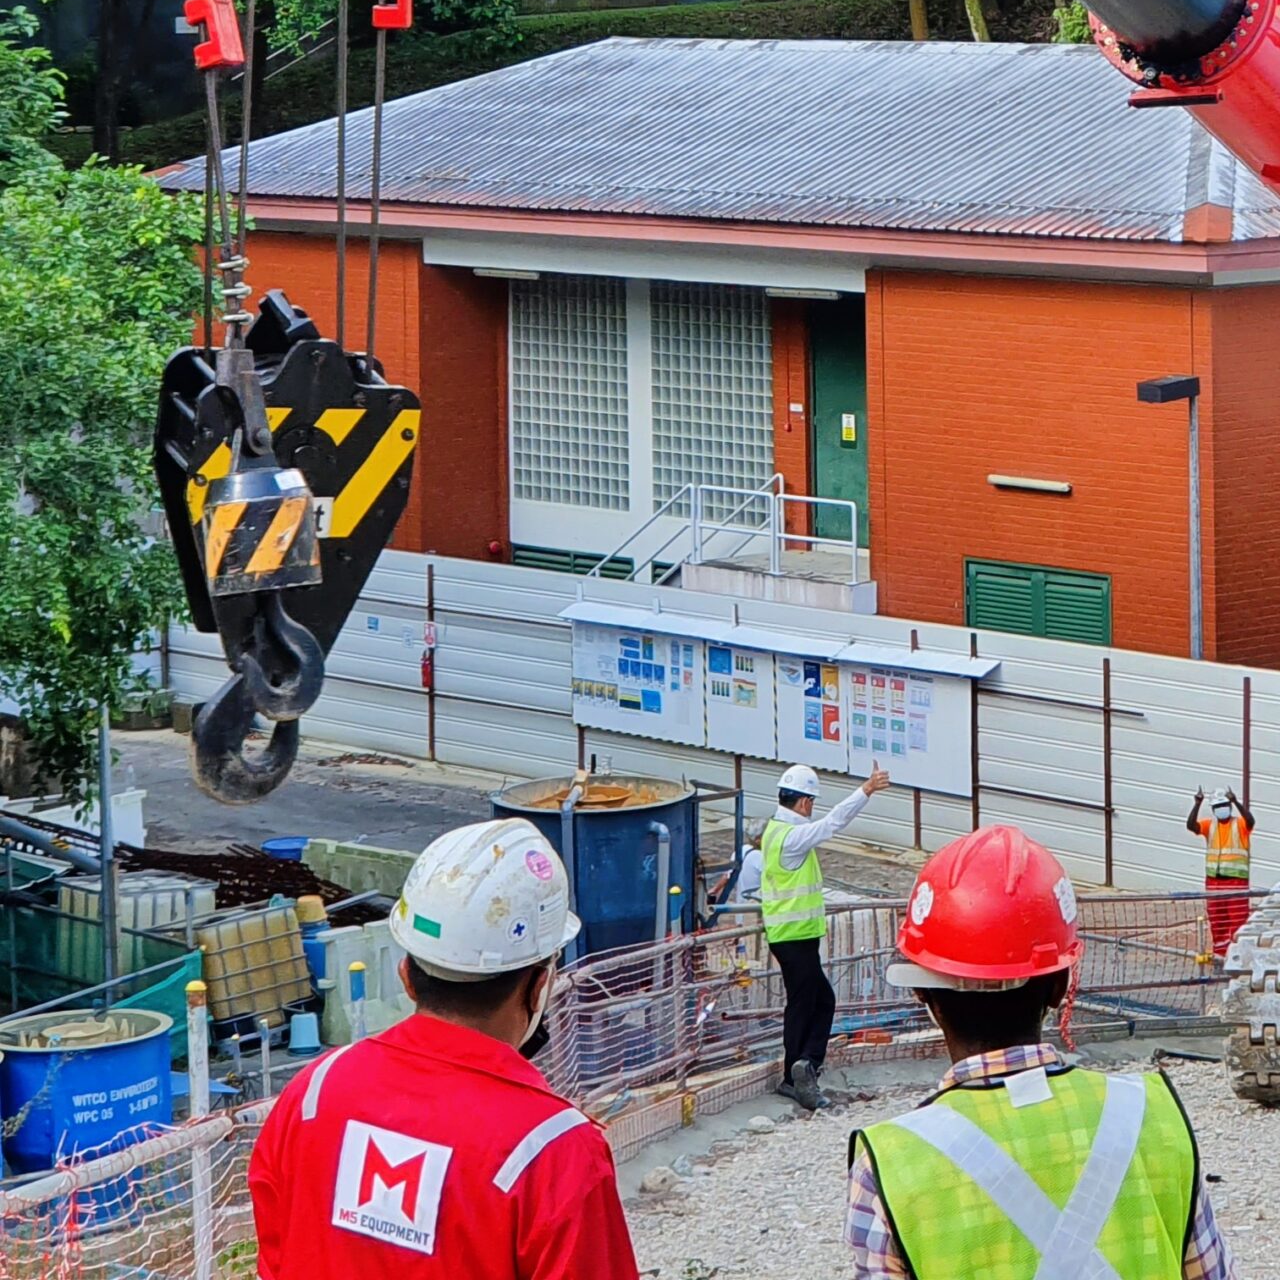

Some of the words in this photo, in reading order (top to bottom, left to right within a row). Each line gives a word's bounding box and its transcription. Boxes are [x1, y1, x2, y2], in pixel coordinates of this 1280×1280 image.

[72, 1091, 107, 1107] WITCO
[73, 1109, 99, 1124] WPC
[101, 1107, 114, 1120] 05
[360, 1214, 430, 1246] EQUIPMENT
